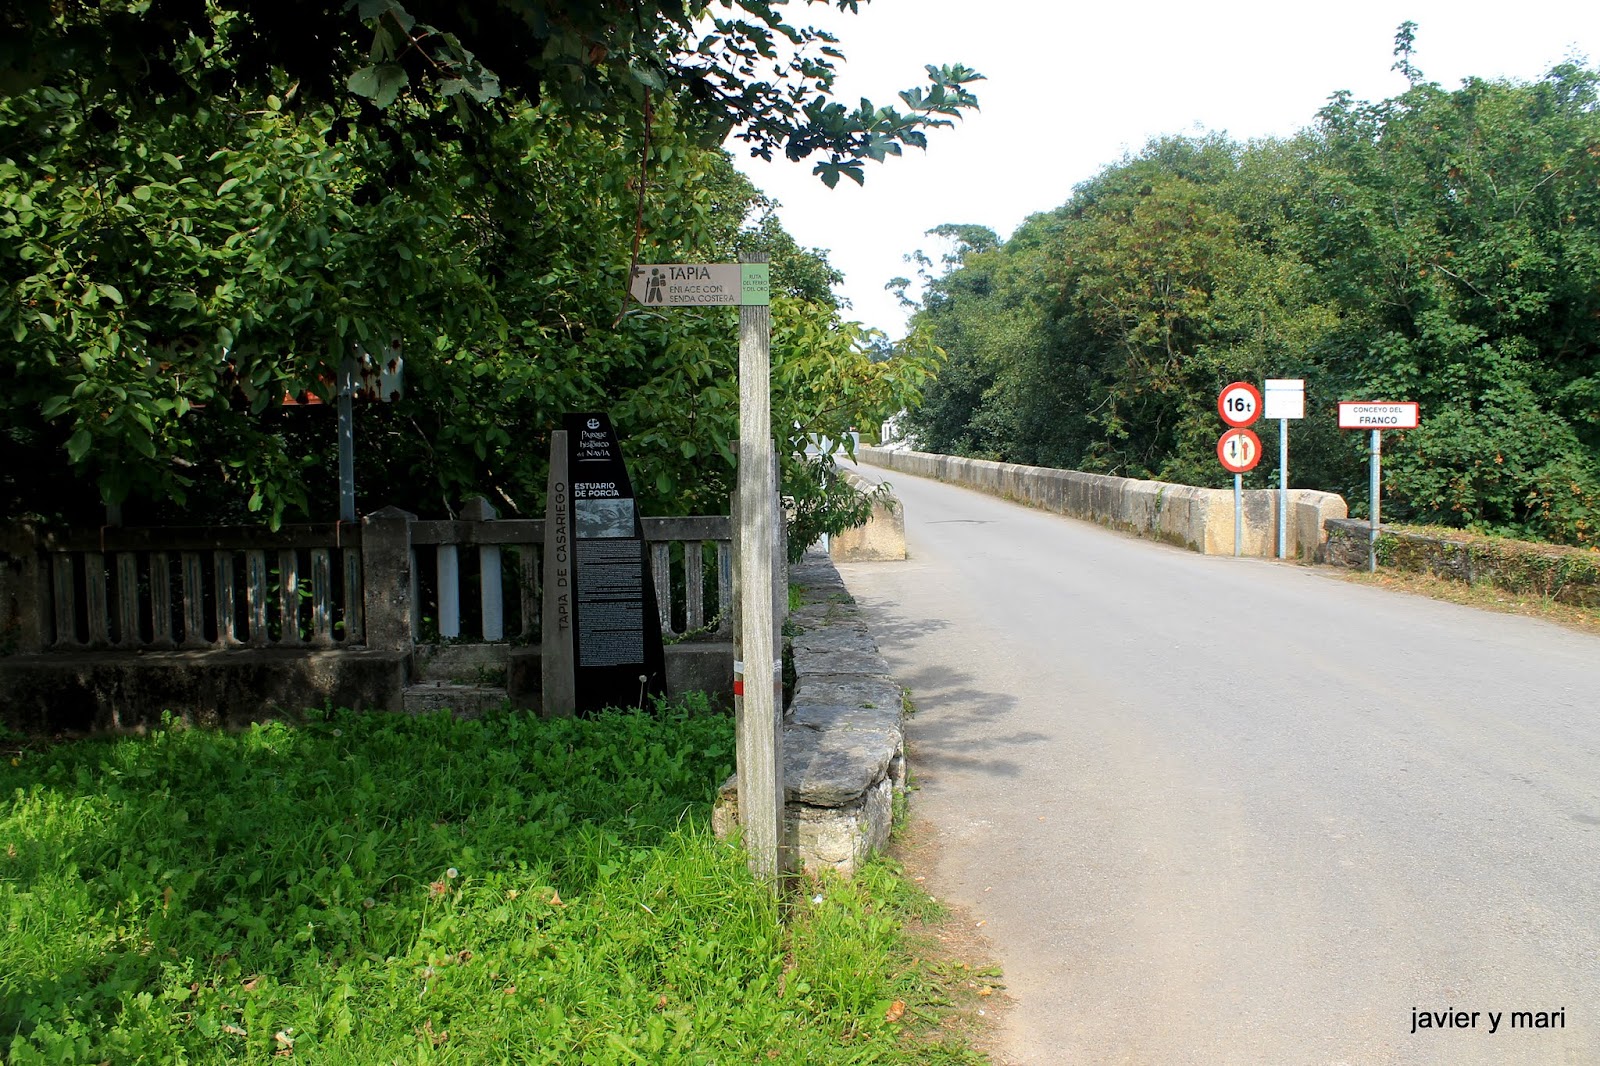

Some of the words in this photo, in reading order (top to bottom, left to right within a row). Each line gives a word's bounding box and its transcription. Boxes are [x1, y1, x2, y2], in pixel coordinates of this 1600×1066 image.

[669, 267, 710, 280] TAPIA
[1359, 416, 1398, 425] FRANCO
[574, 490, 587, 498] DE
[554, 482, 567, 563] CASARIEGO
[557, 568, 568, 587] DE
[559, 593, 569, 632] TAPIA
